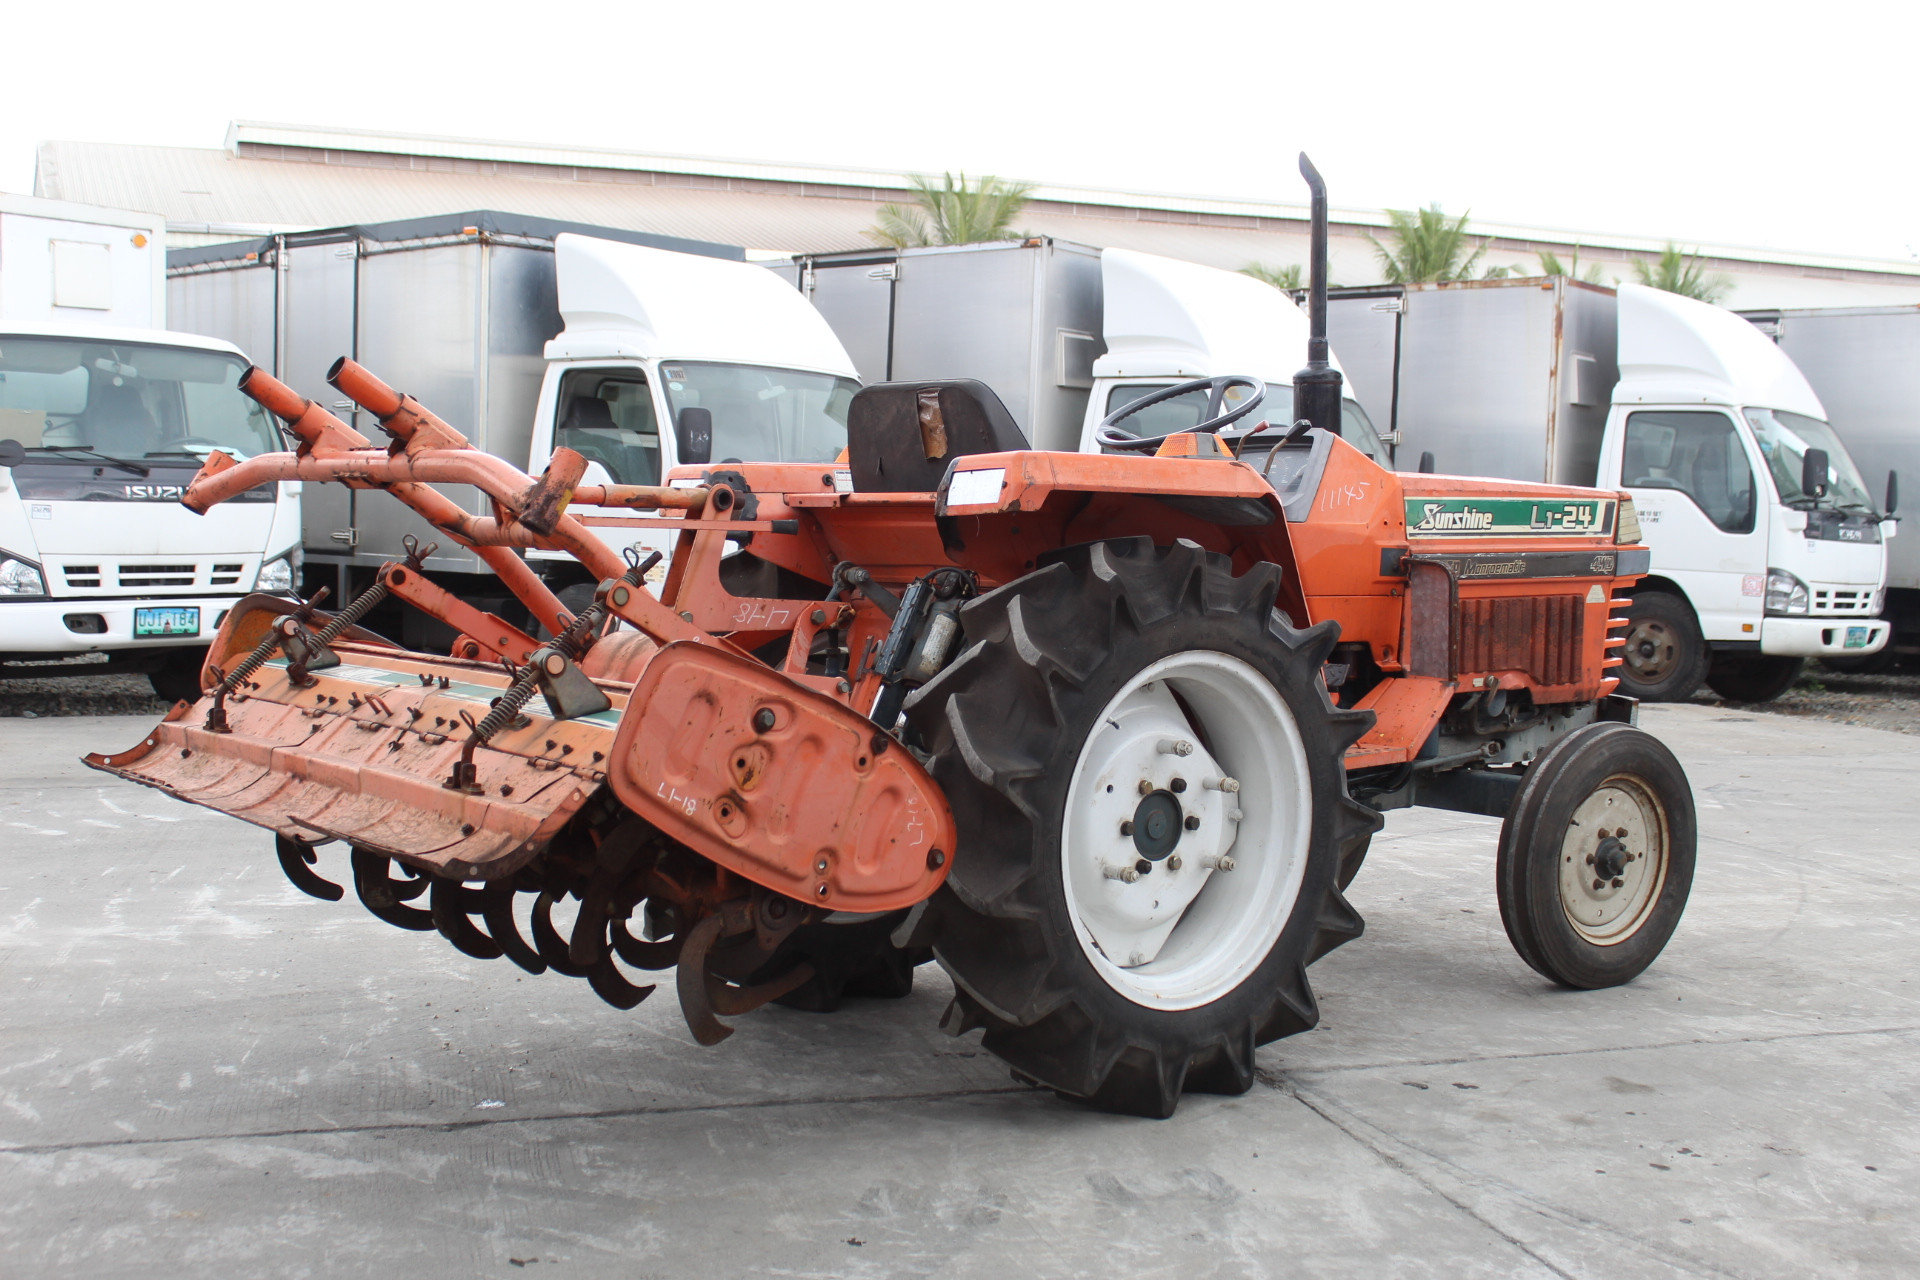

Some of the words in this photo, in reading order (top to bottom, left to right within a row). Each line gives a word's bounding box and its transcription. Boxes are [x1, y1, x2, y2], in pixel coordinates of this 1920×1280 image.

[1321, 481, 1371, 512] 11145
[1413, 503, 1494, 530] Sunshine
[656, 782, 697, 816] L1-18
